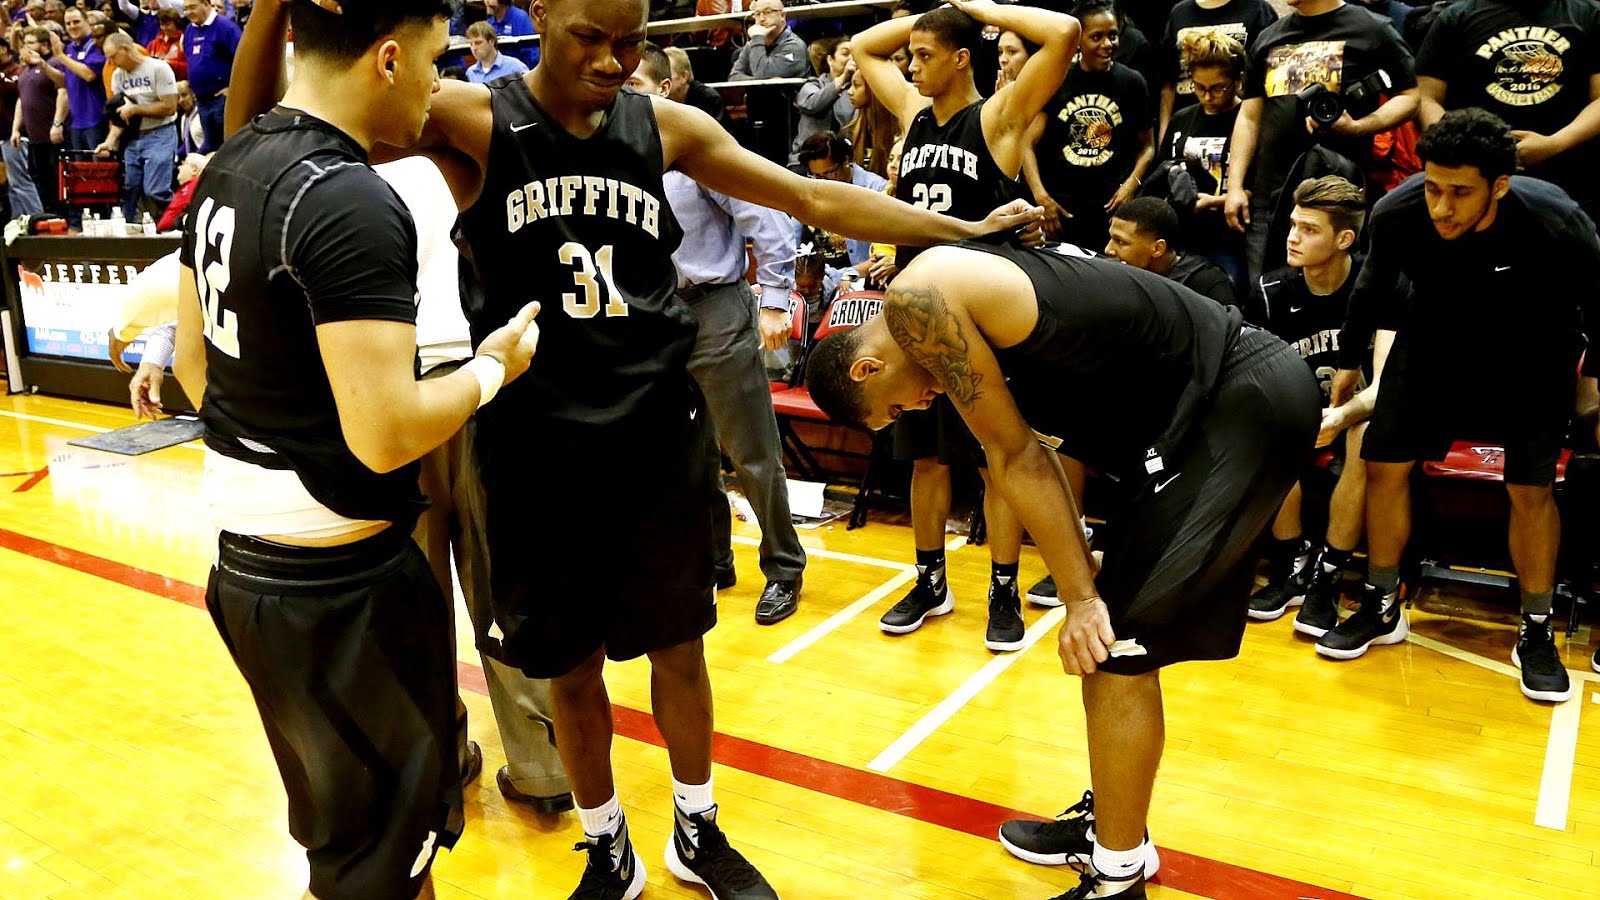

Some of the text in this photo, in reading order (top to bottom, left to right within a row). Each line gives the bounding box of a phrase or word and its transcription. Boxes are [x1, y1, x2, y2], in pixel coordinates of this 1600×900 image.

[1475, 26, 1571, 60] PANTHER
[122, 76, 151, 90] CUBS
[1510, 83, 1541, 91] 2016
[1057, 94, 1123, 127] PANTHER
[506, 175, 660, 240] GRIFFITH
[912, 183, 952, 213] 22
[42, 263, 150, 285] JEFFER
[194, 196, 240, 359] 12
[558, 241, 628, 318] 31
[1146, 447, 1158, 458] XL
